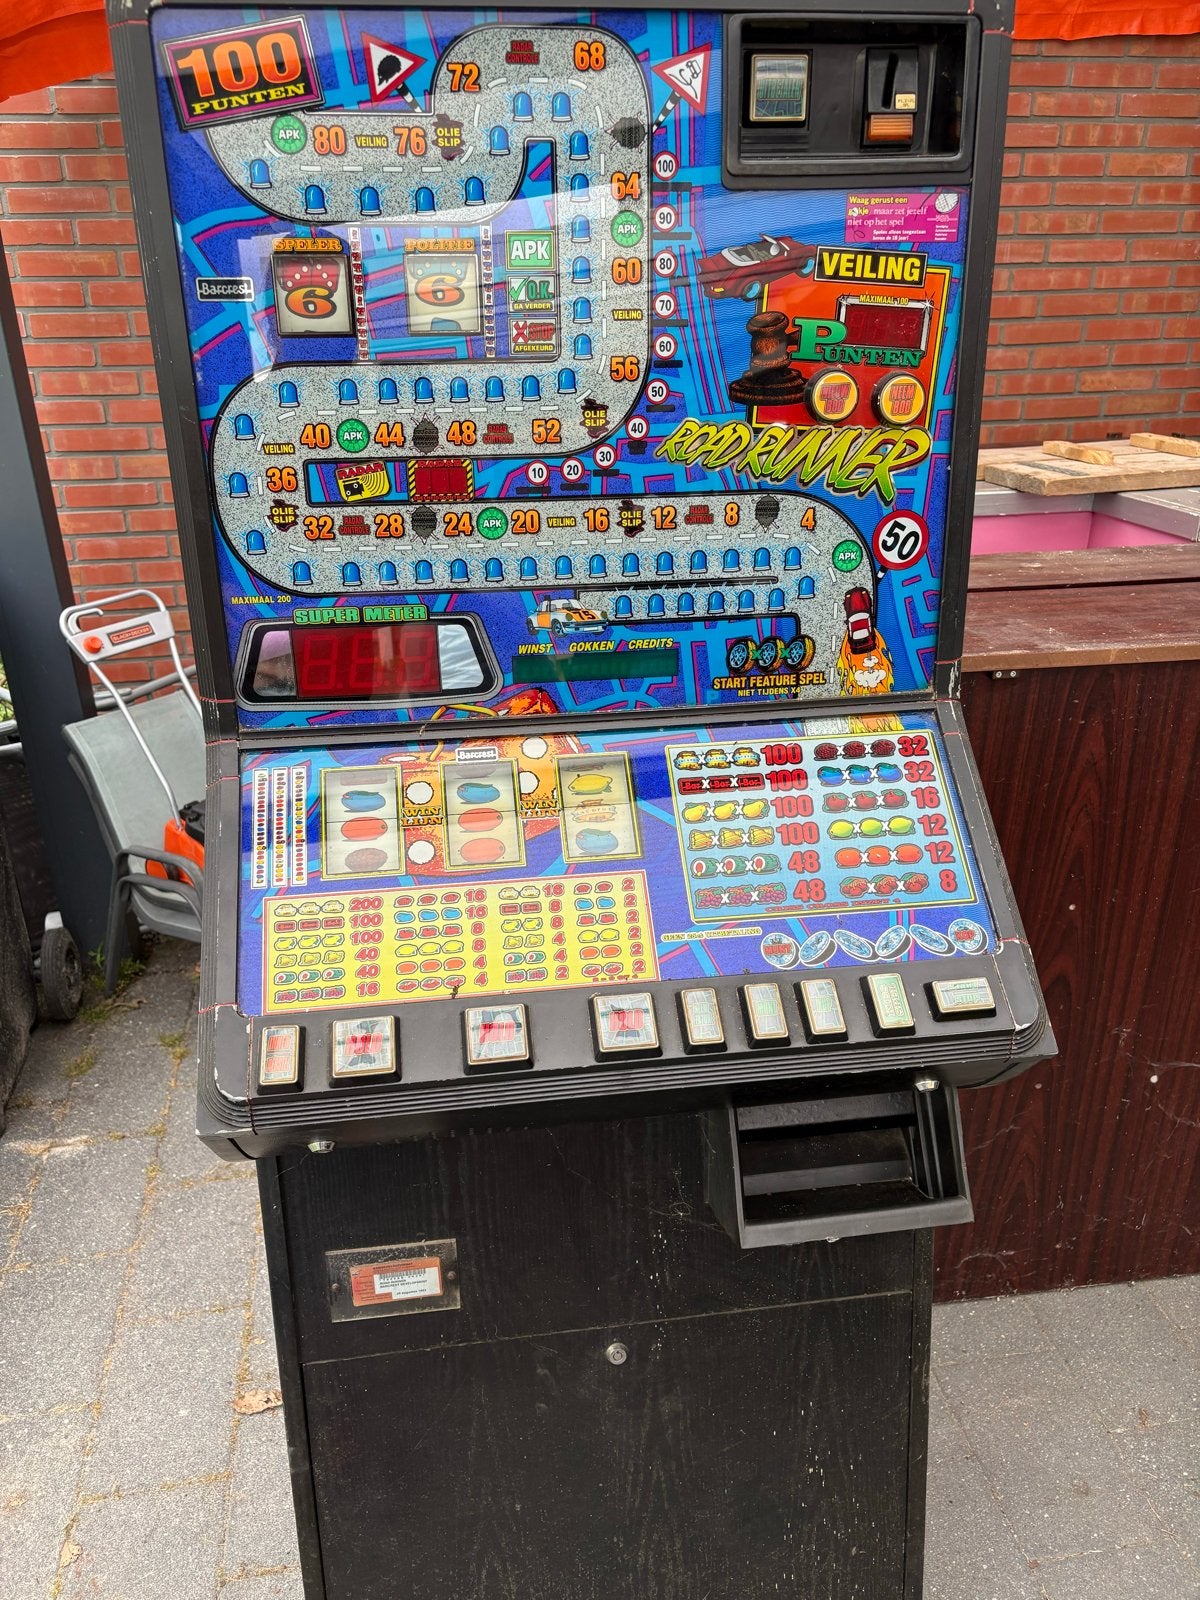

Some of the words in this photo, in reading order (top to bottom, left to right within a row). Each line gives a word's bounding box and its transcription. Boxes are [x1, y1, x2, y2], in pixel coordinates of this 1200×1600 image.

[506, 52, 539, 64] CONTROLE
[574, 40, 605, 71] 68
[177, 32, 302, 98] 100
[447, 62, 480, 92] 72
[192, 83, 305, 115] PUNTEN
[279, 128, 300, 140] APK
[313, 125, 346, 155] 80
[394, 125, 426, 155] 76
[437, 127, 460, 138] OLIE
[355, 135, 387, 148] VEILING
[437, 137, 461, 147] SLIP
[658, 160, 674, 172] 100
[611, 171, 640, 200] 64
[849, 196, 870, 205] Waag
[871, 197, 893, 205] gerust
[659, 212, 672, 224] 90
[906, 207, 927, 216] jezelf
[617, 224, 637, 234] APK
[875, 218, 887, 226] het
[889, 218, 904, 227] spel
[272, 238, 342, 252] SPELER
[511, 241, 549, 260] APK
[612, 257, 642, 285] 60
[660, 258, 672, 270] 80
[823, 252, 920, 281] VEILING
[202, 279, 249, 295] Barcrest
[415, 274, 465, 306] 6
[527, 280, 553, 301] O.K.
[285, 287, 337, 319] 6
[659, 300, 672, 312] 70
[860, 294, 894, 304] MAXIMAAL
[897, 297, 909, 305] 100
[613, 310, 642, 320] VEILING
[529, 323, 555, 341] STOP
[659, 341, 672, 352] 60
[791, 317, 925, 367] PUNTEN
[610, 356, 639, 381] 56
[651, 386, 664, 398] 50
[891, 384, 916, 400] NEEM
[584, 410, 606, 418] OLIE
[487, 424, 507, 433] RADAR
[584, 419, 605, 427] SLIP
[631, 422, 644, 434] 40
[301, 423, 330, 449] 40
[343, 432, 363, 440] APK
[375, 422, 404, 447] 44
[447, 420, 476, 446] 48
[532, 419, 561, 445] 52
[263, 443, 295, 454] VEILING
[599, 451, 612, 462] 30
[656, 420, 750, 468] ROAD
[737, 426, 931, 501] RUNNER
[337, 463, 383, 479] RADAR
[532, 468, 544, 478] 10
[566, 464, 579, 476] 20
[266, 466, 297, 492] 36
[272, 507, 294, 516] OLIE
[621, 510, 642, 519] OLIE
[651, 505, 677, 530] 12
[724, 501, 740, 527] 8
[273, 515, 295, 524] SLIP
[343, 516, 364, 525] RADAR
[375, 513, 404, 538] 28
[444, 512, 473, 537] 24
[483, 519, 501, 528] APK
[511, 509, 540, 534] 20
[547, 517, 576, 528] VEILING
[584, 507, 609, 532] 16
[621, 518, 642, 527] SLIP
[685, 515, 713, 525] CONTROLE
[801, 508, 815, 531] 4
[304, 515, 334, 540] 32
[339, 525, 370, 535] CONTROLE
[881, 520, 920, 560] 50
[838, 552, 857, 560] APK
[231, 596, 275, 604] MAXIMAAL
[277, 595, 292, 604] 200
[294, 608, 360, 624] SUPER
[363, 605, 428, 622] METER
[573, 609, 596, 620] 75
[518, 644, 553, 654] WINST
[569, 641, 615, 652] GOKKEN
[628, 638, 673, 649] CREDITS
[713, 676, 747, 689] START
[750, 674, 797, 688] FEATURE
[799, 672, 826, 686] SPEL
[757, 688, 789, 696] TIJDENS
[898, 735, 929, 757] 32
[457, 750, 495, 760] Barcrest
[760, 743, 803, 766] 100
[904, 760, 936, 783] 32
[765, 769, 808, 791] 100
[521, 800, 557, 810] WIN
[911, 786, 940, 809] 16
[403, 807, 441, 817] WIN
[520, 809, 560, 819] LIJN
[770, 795, 813, 818] 100
[401, 816, 443, 827] LIJN
[918, 813, 948, 837] 12
[776, 822, 820, 845] 100
[925, 841, 955, 864] 12
[788, 850, 820, 873] 48
[622, 877, 635, 892] 2
[939, 869, 957, 892] 8
[464, 888, 487, 903] 16
[543, 883, 565, 897] 16
[793, 879, 826, 902] 48
[349, 897, 383, 911] 200
[465, 904, 488, 919] 16
[549, 899, 562, 913] 8
[350, 913, 383, 928] 100
[471, 921, 485, 936] 8
[955, 929, 976, 941] KOP
[552, 931, 566, 946] 4
[355, 947, 380, 961] 40
[473, 954, 487, 969] 4
[555, 965, 569, 980] 2
[632, 959, 646, 974] 2
[356, 981, 380, 997] 16
